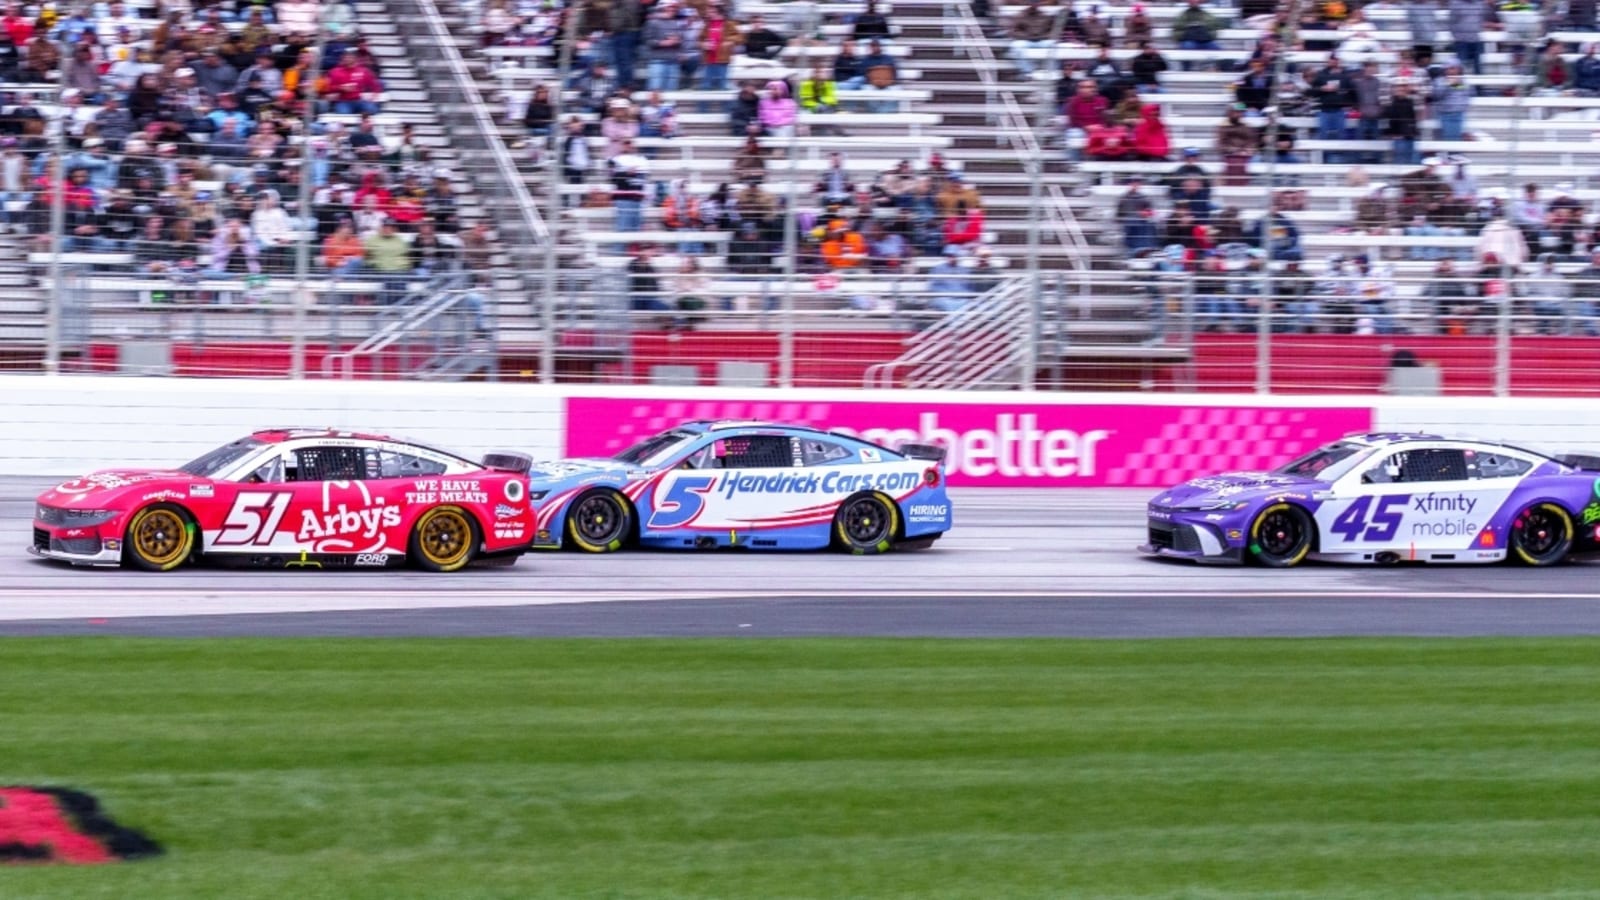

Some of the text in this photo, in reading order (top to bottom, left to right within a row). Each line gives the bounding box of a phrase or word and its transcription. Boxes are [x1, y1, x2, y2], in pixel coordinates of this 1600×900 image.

[414, 480, 480, 491] WE HAVE
[405, 491, 488, 504] THE MEATS
[647, 475, 718, 528] 5
[1414, 491, 1478, 515] xfinity
[213, 490, 293, 546] 51
[297, 496, 401, 540] Arby's
[909, 504, 948, 516] HIRING
[1330, 494, 1413, 542] 45
[1412, 518, 1478, 536] mobile
[356, 553, 389, 563] FORD
